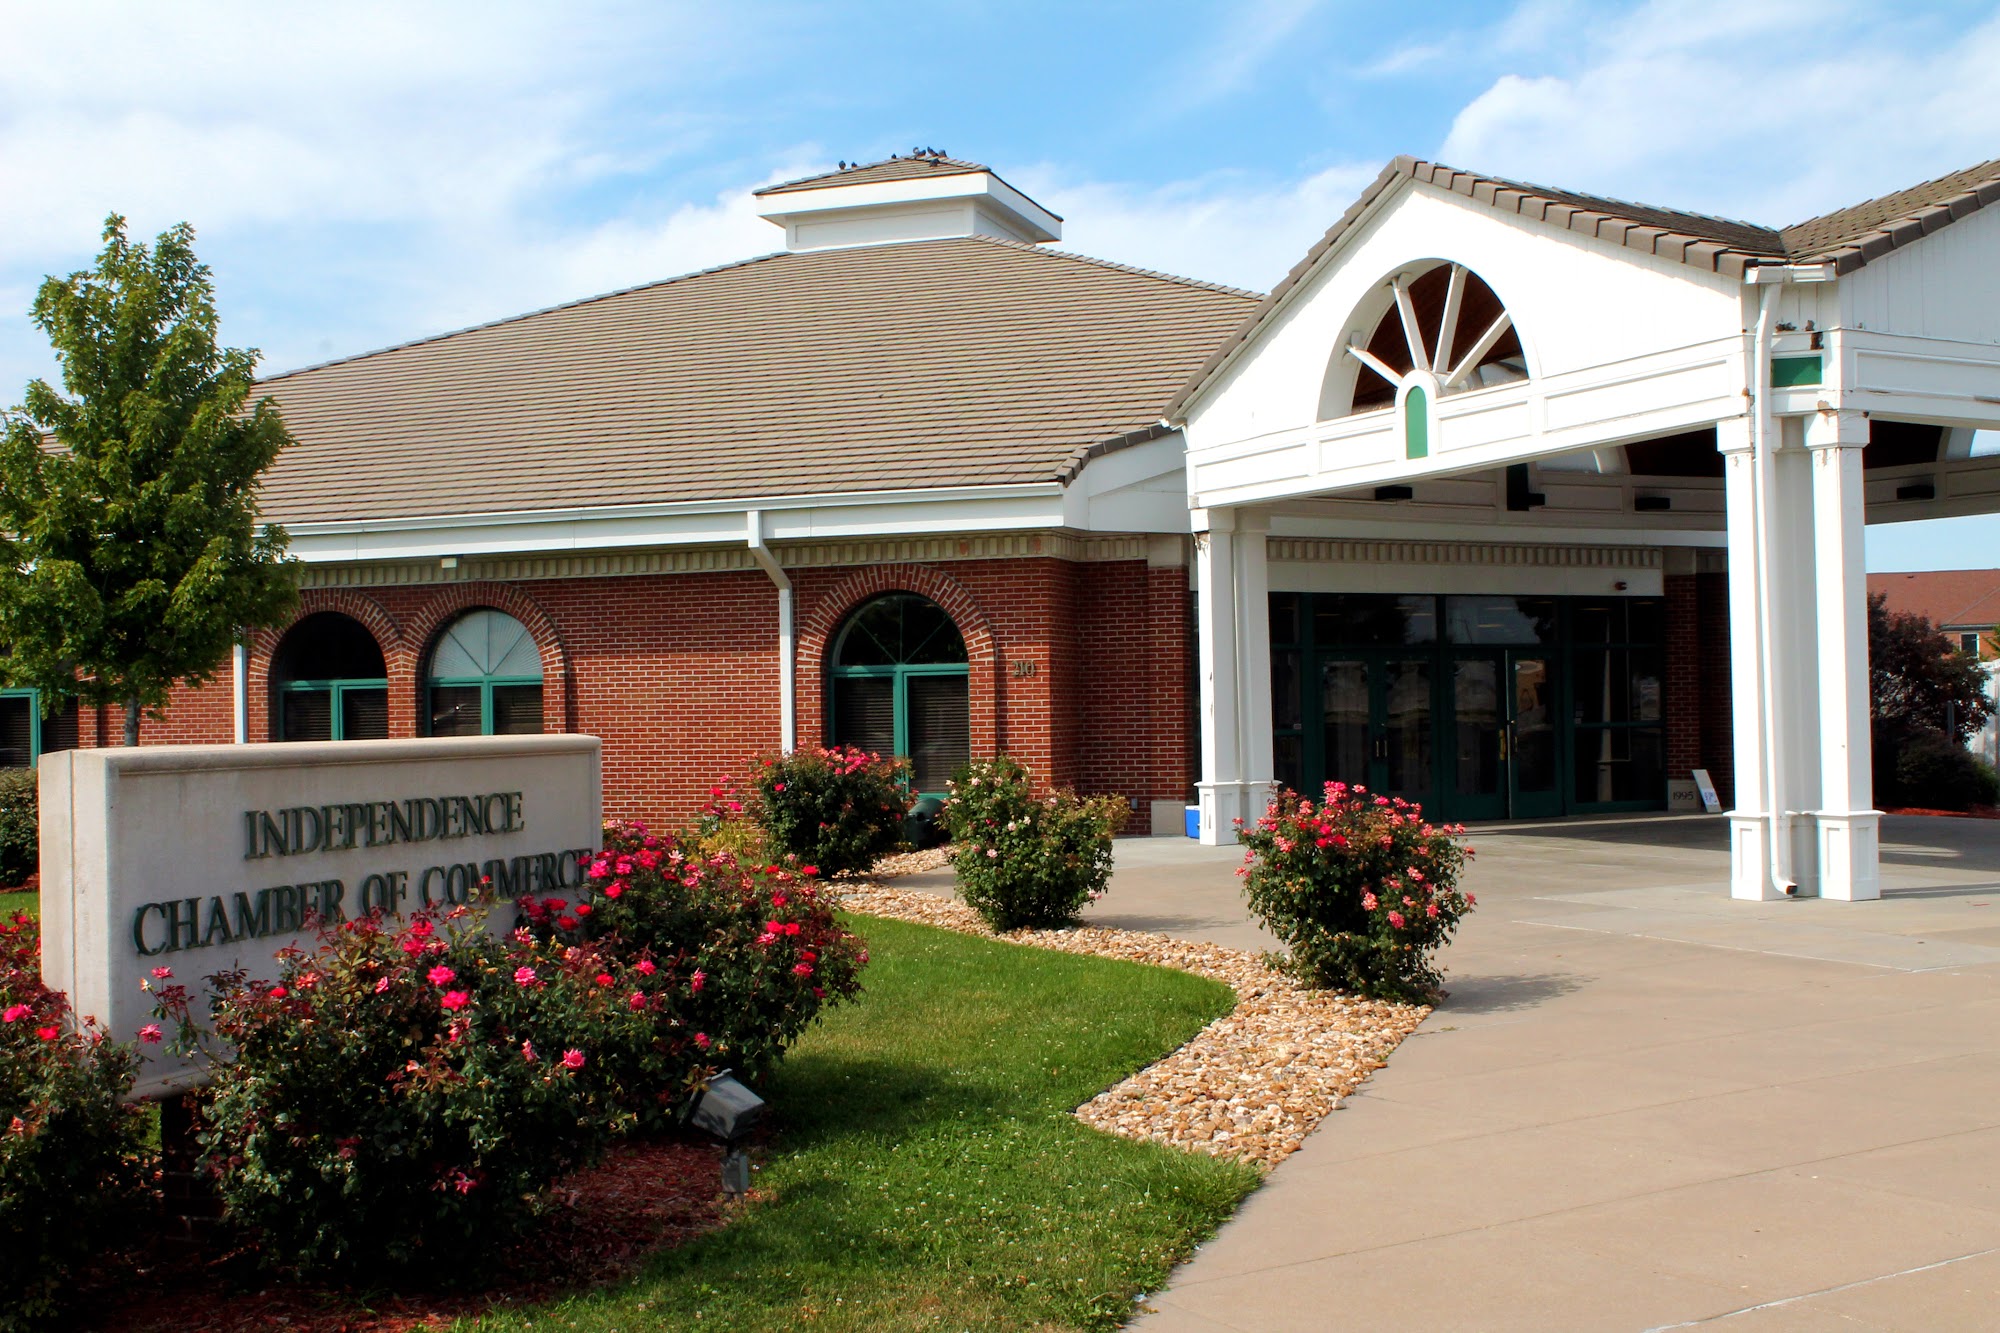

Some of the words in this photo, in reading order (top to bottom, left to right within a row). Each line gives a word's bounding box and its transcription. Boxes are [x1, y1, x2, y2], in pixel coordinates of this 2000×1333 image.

[1012, 660, 1036, 677] 210
[1672, 791, 1695, 801] 1995
[244, 791, 526, 860] INDEPENDENCE
[133, 879, 347, 957] CHAMBER
[361, 871, 408, 919] OF
